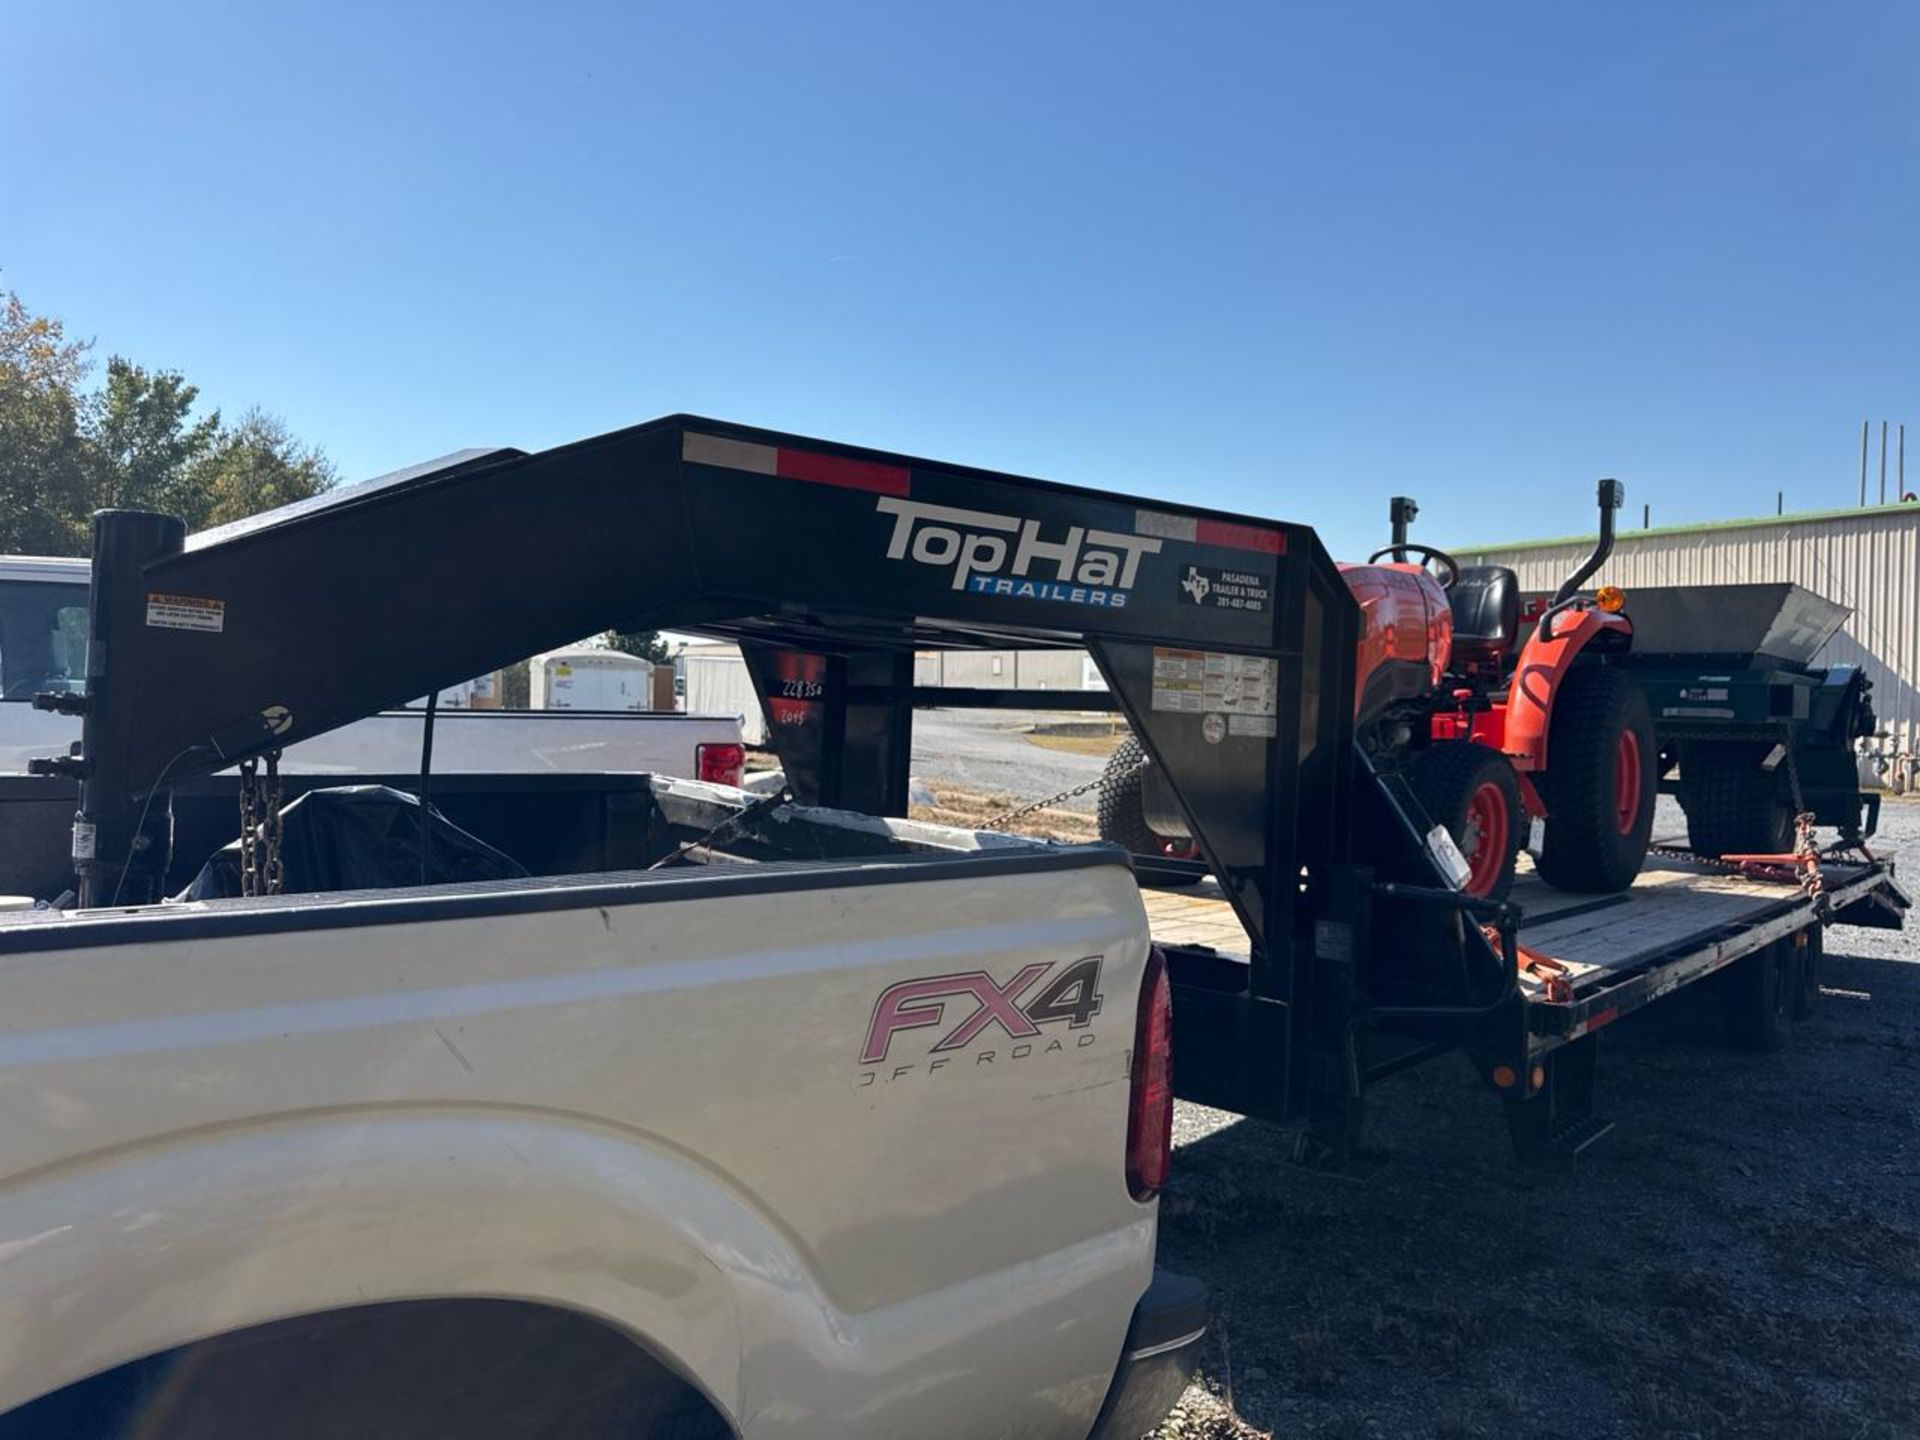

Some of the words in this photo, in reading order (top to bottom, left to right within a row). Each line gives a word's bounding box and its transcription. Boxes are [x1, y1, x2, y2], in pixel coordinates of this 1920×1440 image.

[975, 576, 1126, 607] TRAILERS
[1213, 583, 1239, 595] TRAILER
[1247, 587, 1268, 599] TRUCK
[1222, 572, 1259, 585] PASADENA
[859, 955, 1104, 1065] FX4
[976, 1034, 1096, 1066] ROAD
